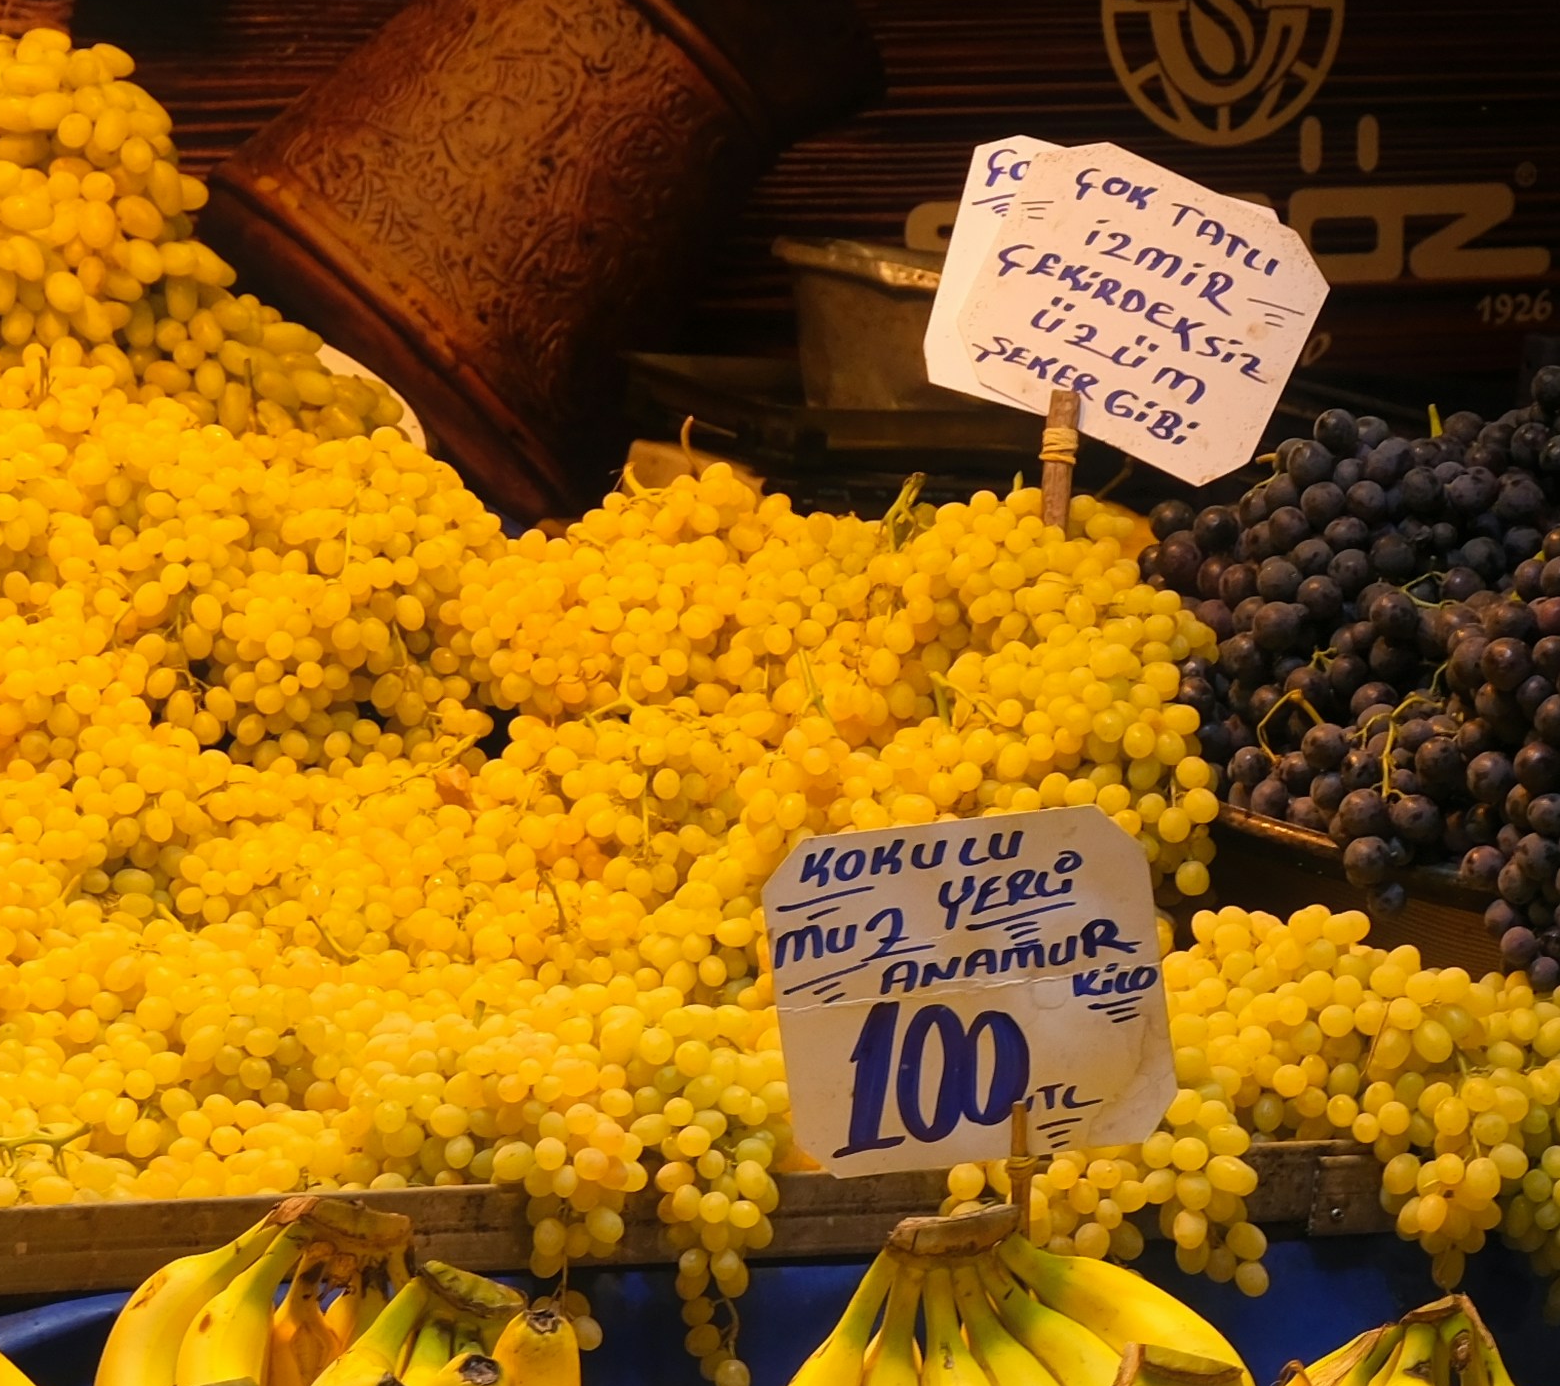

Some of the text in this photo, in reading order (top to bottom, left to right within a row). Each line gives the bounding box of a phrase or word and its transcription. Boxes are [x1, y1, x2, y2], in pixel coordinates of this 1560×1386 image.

[985, 148, 1032, 188] ÇO
[1075, 167, 1280, 276] ÇOK TATLI
[1084, 219, 1235, 316] İZMİR
[997, 243, 1268, 385] ÇEKİRDEKSİZ
[1030, 296, 1207, 406] ÜZÜM
[1474, 289, 1554, 325] 1926
[972, 335, 1201, 446] ŞEKER GİBİ
[799, 830, 1025, 888] KOKULU
[774, 908, 936, 970] MUZ
[880, 919, 1142, 995] ANAMUR
[832, 1001, 1030, 1158] 100
